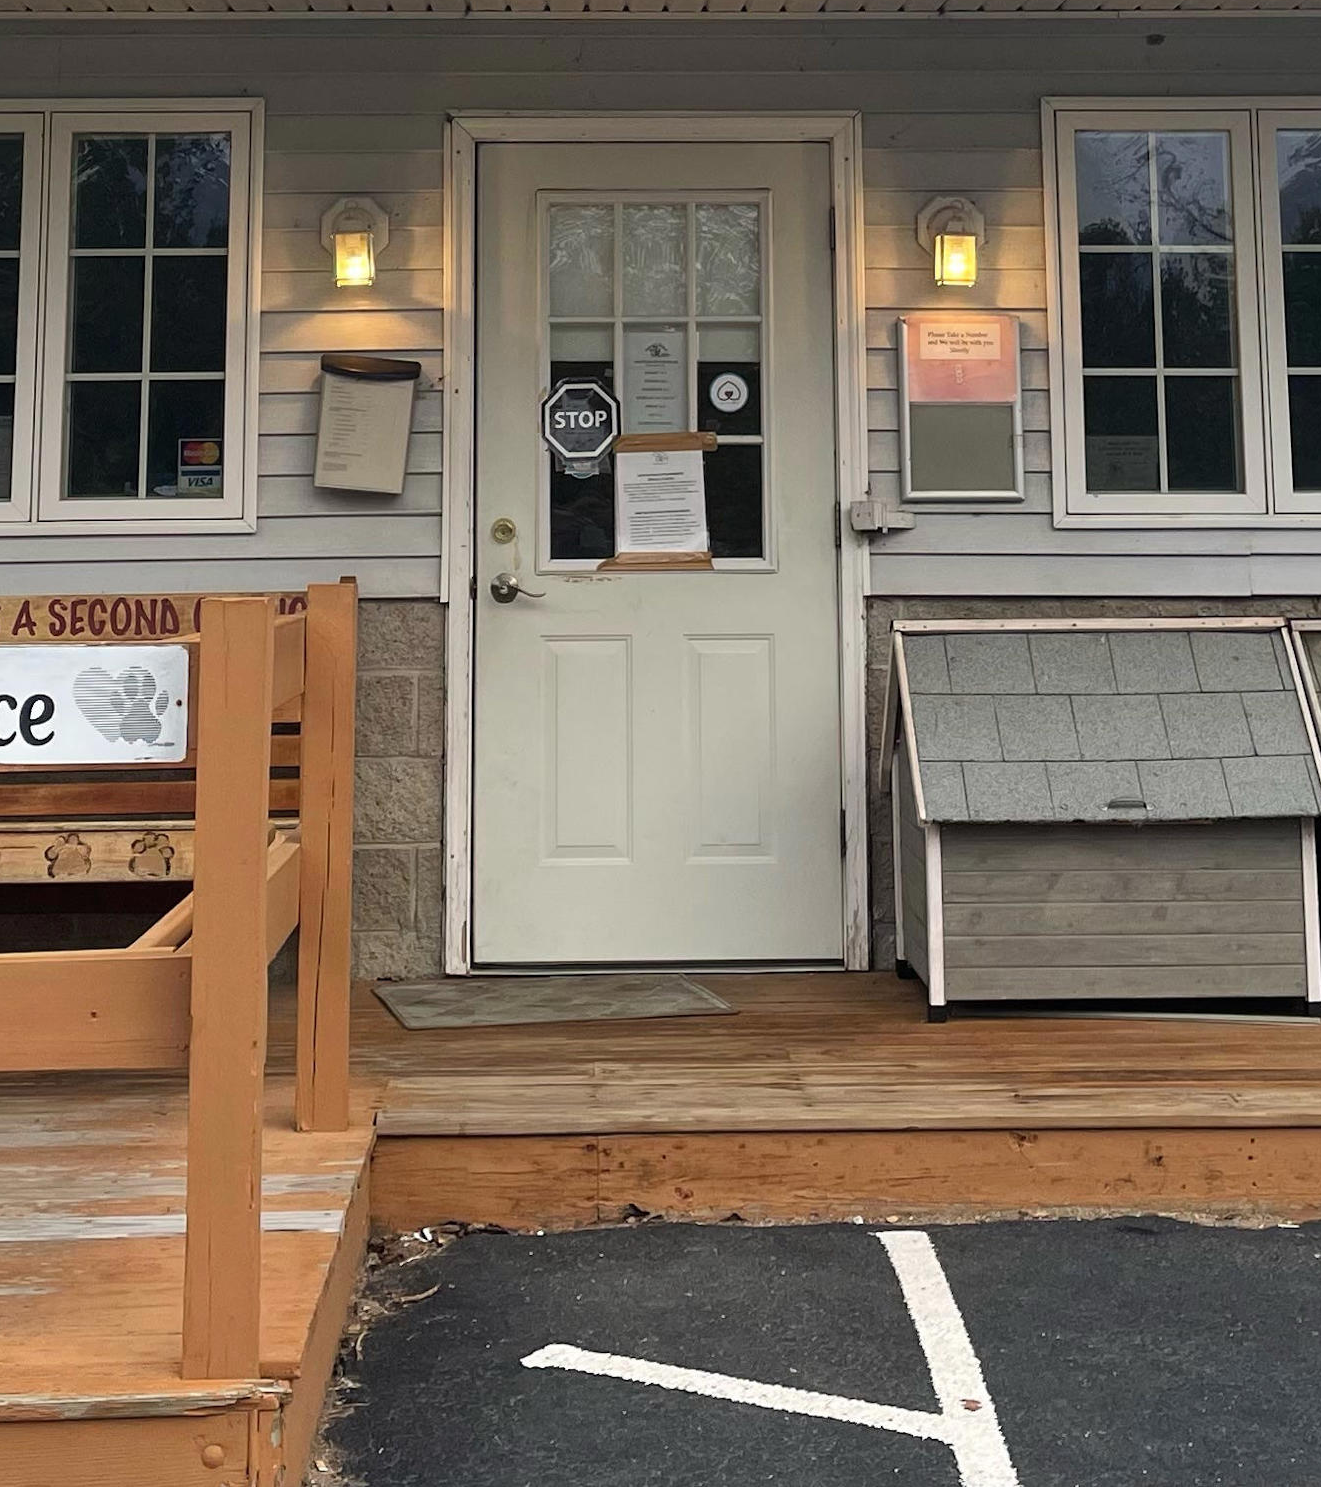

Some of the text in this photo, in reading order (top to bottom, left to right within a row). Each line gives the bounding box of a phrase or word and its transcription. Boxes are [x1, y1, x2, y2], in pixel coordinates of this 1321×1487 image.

[554, 410, 608, 429] STOP
[188, 476, 214, 487] VISA
[11, 600, 37, 636] A
[48, 597, 180, 637] SECOND
